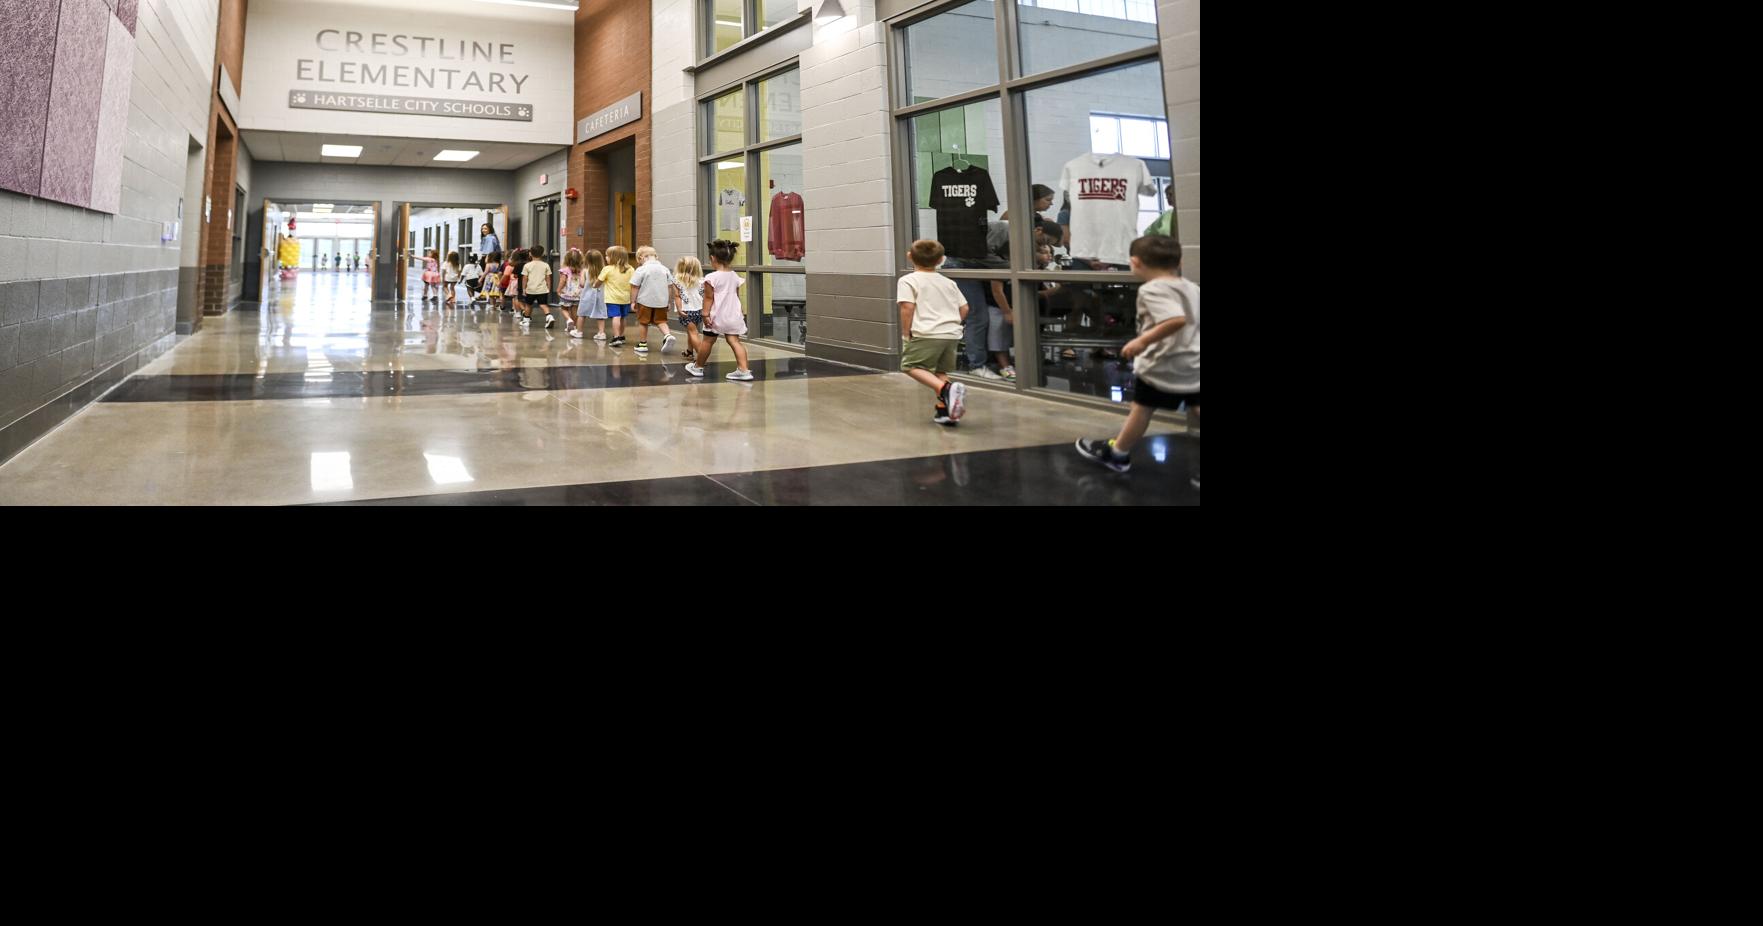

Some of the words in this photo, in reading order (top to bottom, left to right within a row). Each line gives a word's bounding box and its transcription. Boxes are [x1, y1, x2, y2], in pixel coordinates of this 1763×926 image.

[315, 28, 515, 64] CRESTLINE
[296, 58, 529, 94] ELEMENTARY
[314, 94, 399, 111] HARTSELLE
[404, 99, 440, 112] CITY
[443, 102, 511, 116] SCHOOLS
[585, 105, 630, 133] CAFETERIA
[942, 184, 977, 198] TIGERS
[1078, 178, 1128, 195] TIGERS
